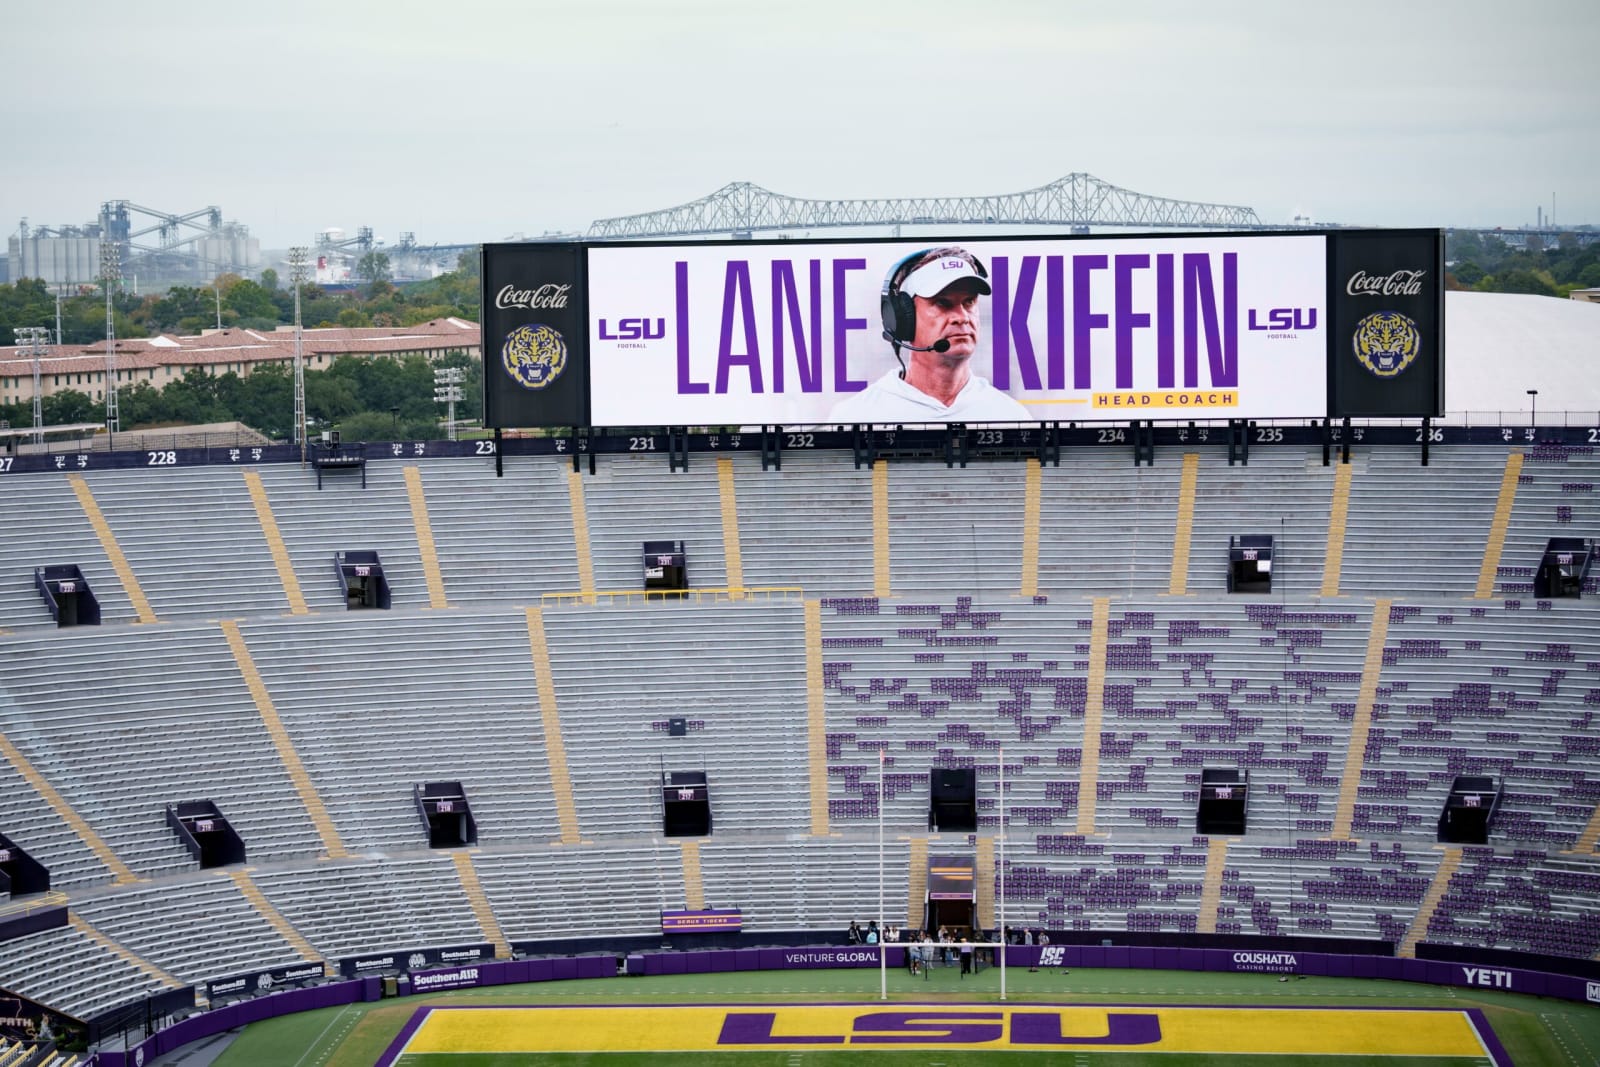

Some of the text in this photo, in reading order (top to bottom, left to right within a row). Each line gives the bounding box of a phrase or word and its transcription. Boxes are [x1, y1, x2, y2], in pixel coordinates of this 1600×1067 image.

[942, 261, 963, 269] LSU
[675, 252, 1238, 395] LANE KIFFIN
[1248, 308, 1317, 330] LSU
[599, 318, 665, 340] LSU
[1099, 394, 1232, 405] HEAD COACH
[787, 434, 815, 448] 232
[977, 431, 1003, 444] 233
[1098, 429, 1126, 443] 234
[1256, 428, 1284, 442] 235
[475, 441, 496, 454] 23
[629, 437, 656, 450] 231
[148, 451, 177, 466] 228
[786, 952, 878, 963] VENTURE GLOBAL
[1233, 952, 1297, 965] COUSHATTA
[1462, 967, 1512, 988] YETI
[717, 1012, 1162, 1045] LSU
